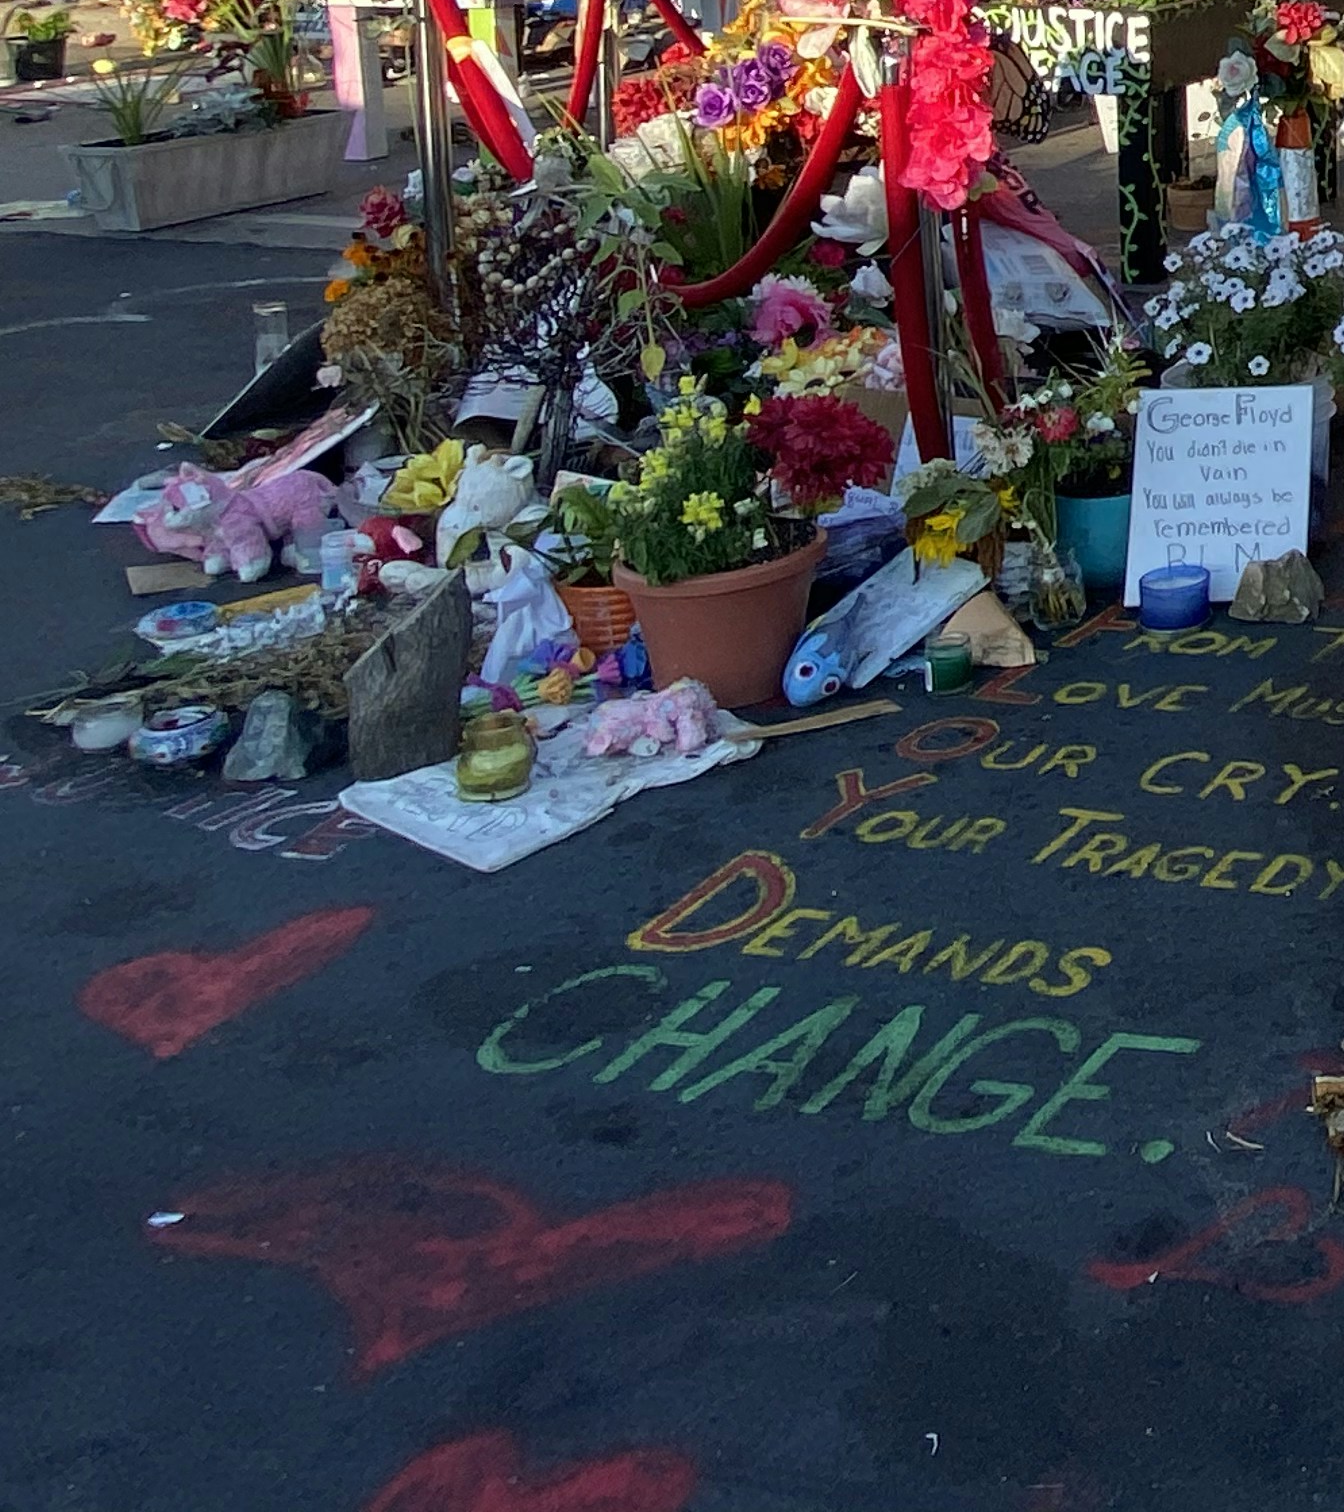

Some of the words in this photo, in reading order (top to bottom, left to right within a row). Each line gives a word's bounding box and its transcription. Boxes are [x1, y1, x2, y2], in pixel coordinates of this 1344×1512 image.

[1030, 48, 1126, 95] EACE
[1147, 396, 1231, 434] George
[1235, 393, 1293, 427] Floyd
[1147, 439, 1174, 464] You
[1232, 440, 1256, 455] die
[1264, 440, 1287, 453] in
[1142, 488, 1168, 510] You
[1205, 489, 1263, 509] always
[1272, 489, 1294, 504] be
[1153, 516, 1291, 538] remembered
[975, 666, 1209, 713] LOVE
[895, 716, 1097, 778] OUR
[799, 768, 1007, 854] YOUR
[625, 848, 1113, 998] DEMANDS
